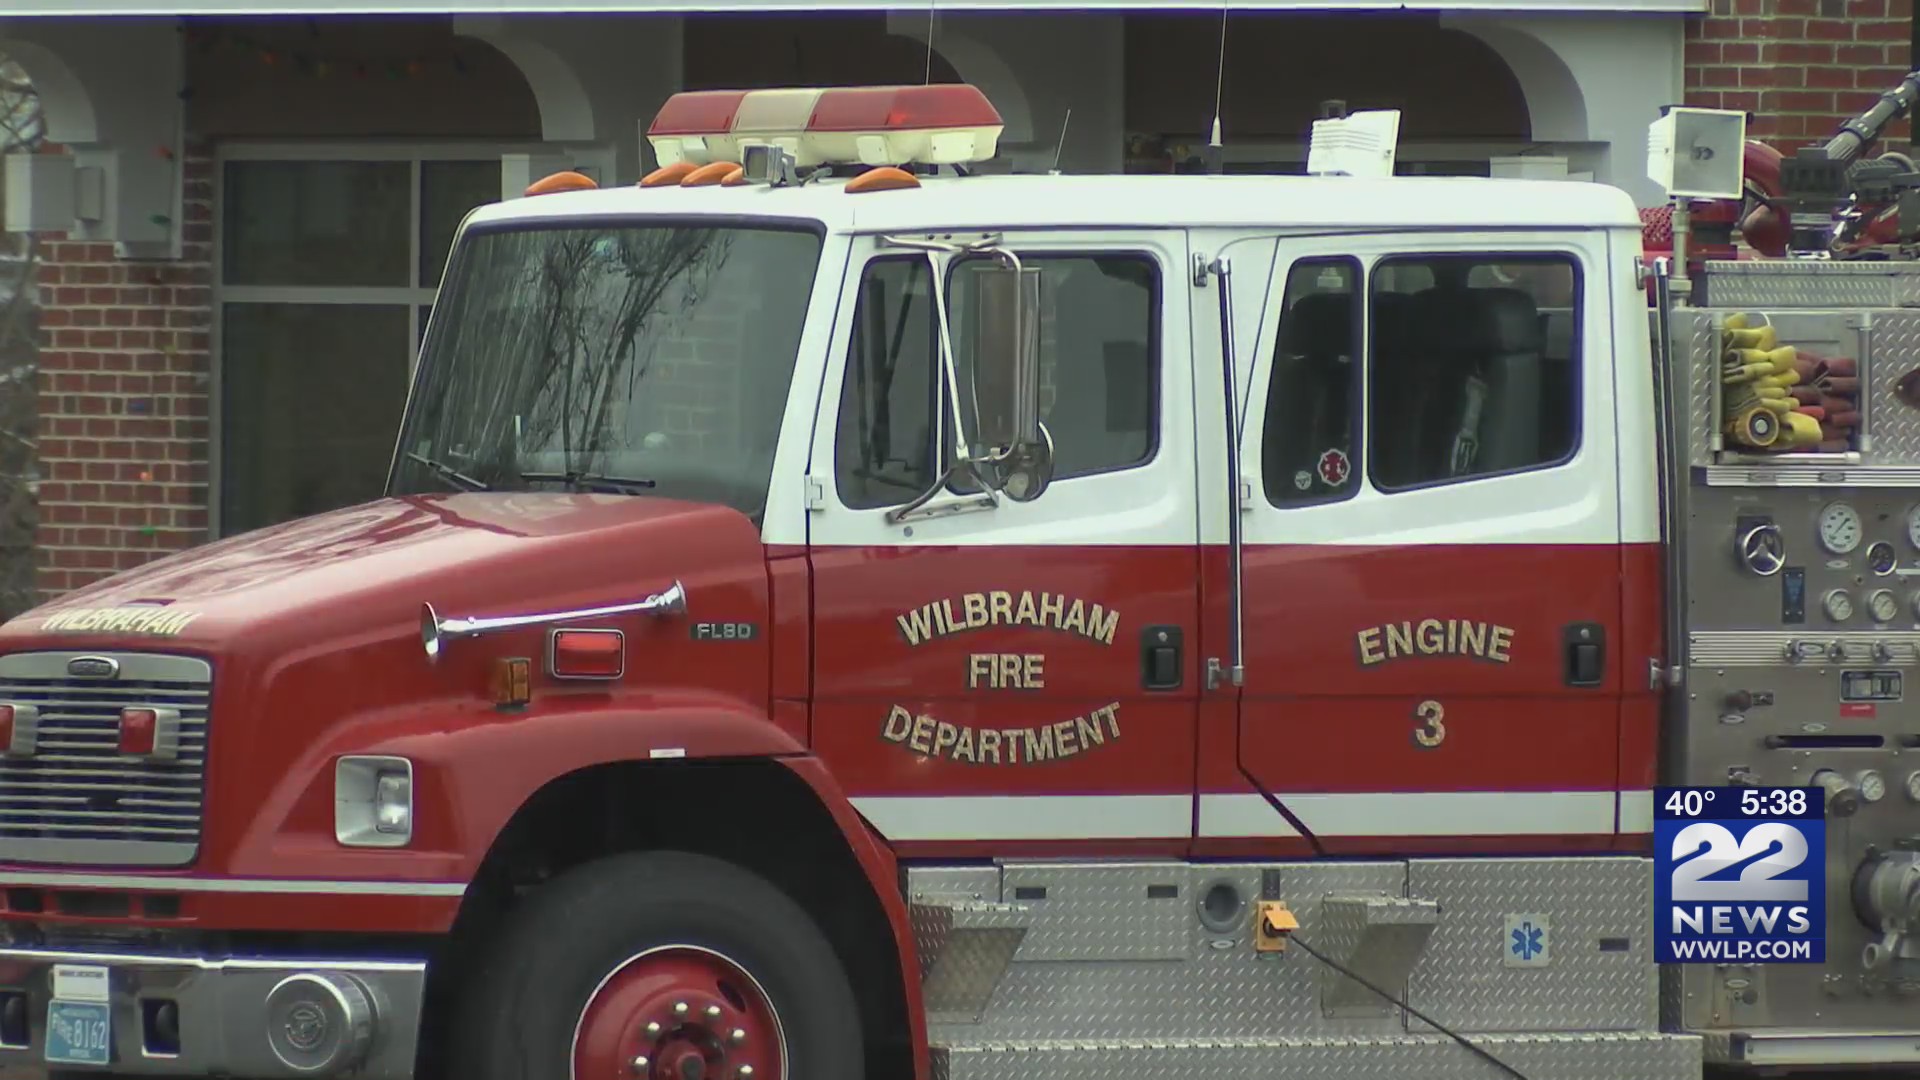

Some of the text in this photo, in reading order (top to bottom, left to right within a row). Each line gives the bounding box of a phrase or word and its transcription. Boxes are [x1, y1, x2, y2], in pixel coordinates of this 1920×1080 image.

[40, 608, 202, 635] WILBRAHAM
[897, 590, 1120, 646] WILBRAHAM
[1357, 618, 1515, 664] ENGINE
[970, 653, 1045, 689] FIRE
[883, 701, 1121, 764] DEPARTMENT
[1415, 700, 1446, 746] 3
